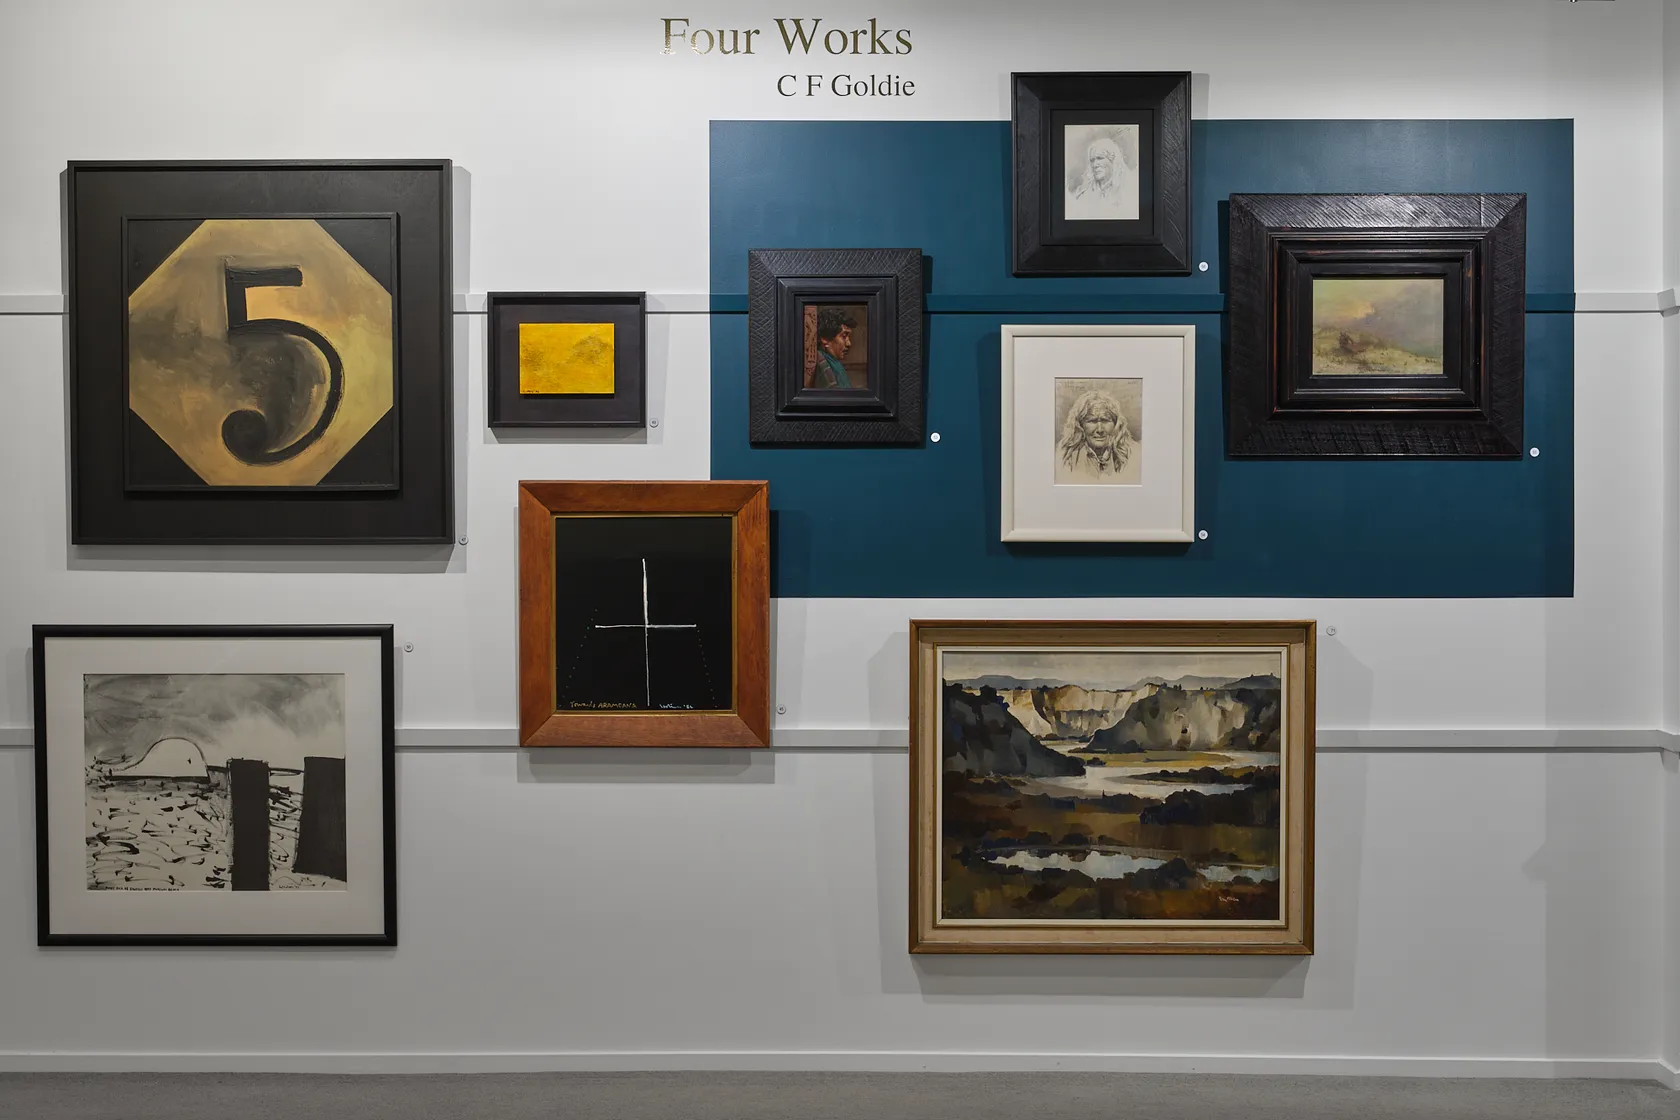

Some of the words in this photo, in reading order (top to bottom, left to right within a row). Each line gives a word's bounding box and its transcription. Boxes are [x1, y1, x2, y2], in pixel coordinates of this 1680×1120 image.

[659, 18, 761, 55] Four
[773, 17, 913, 55] Works
[777, 74, 797, 97] C
[806, 74, 823, 97] F
[831, 74, 916, 97] Goldie
[221, 258, 346, 467] 5
